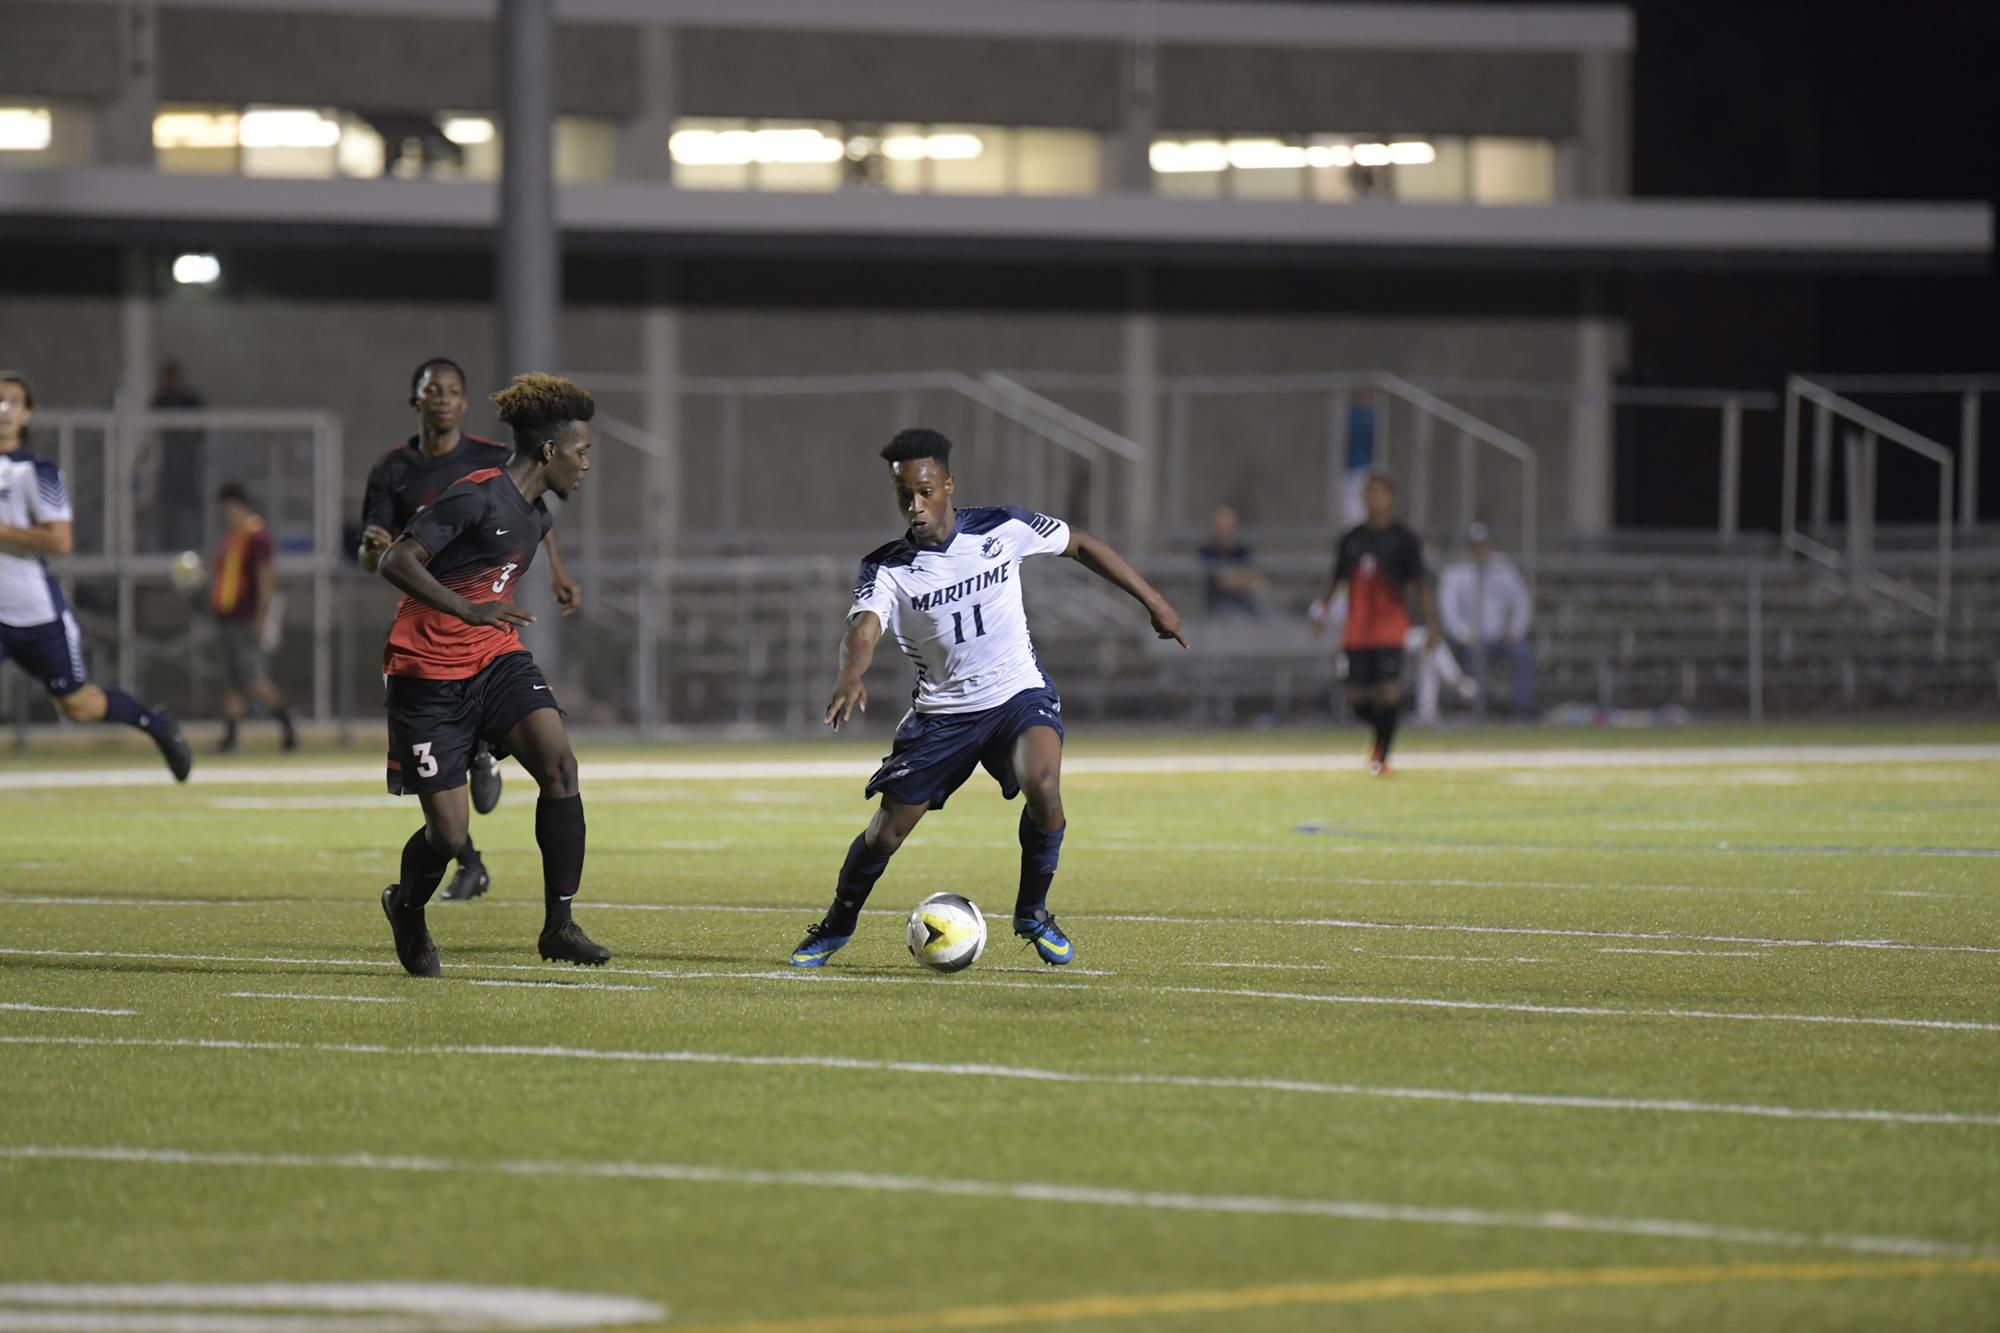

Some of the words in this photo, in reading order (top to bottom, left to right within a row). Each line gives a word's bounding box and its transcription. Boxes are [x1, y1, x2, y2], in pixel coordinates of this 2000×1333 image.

[492, 562, 518, 593] 3
[911, 560, 1010, 612] MARITIME
[951, 603, 986, 645] 11
[412, 741, 439, 778] 3
